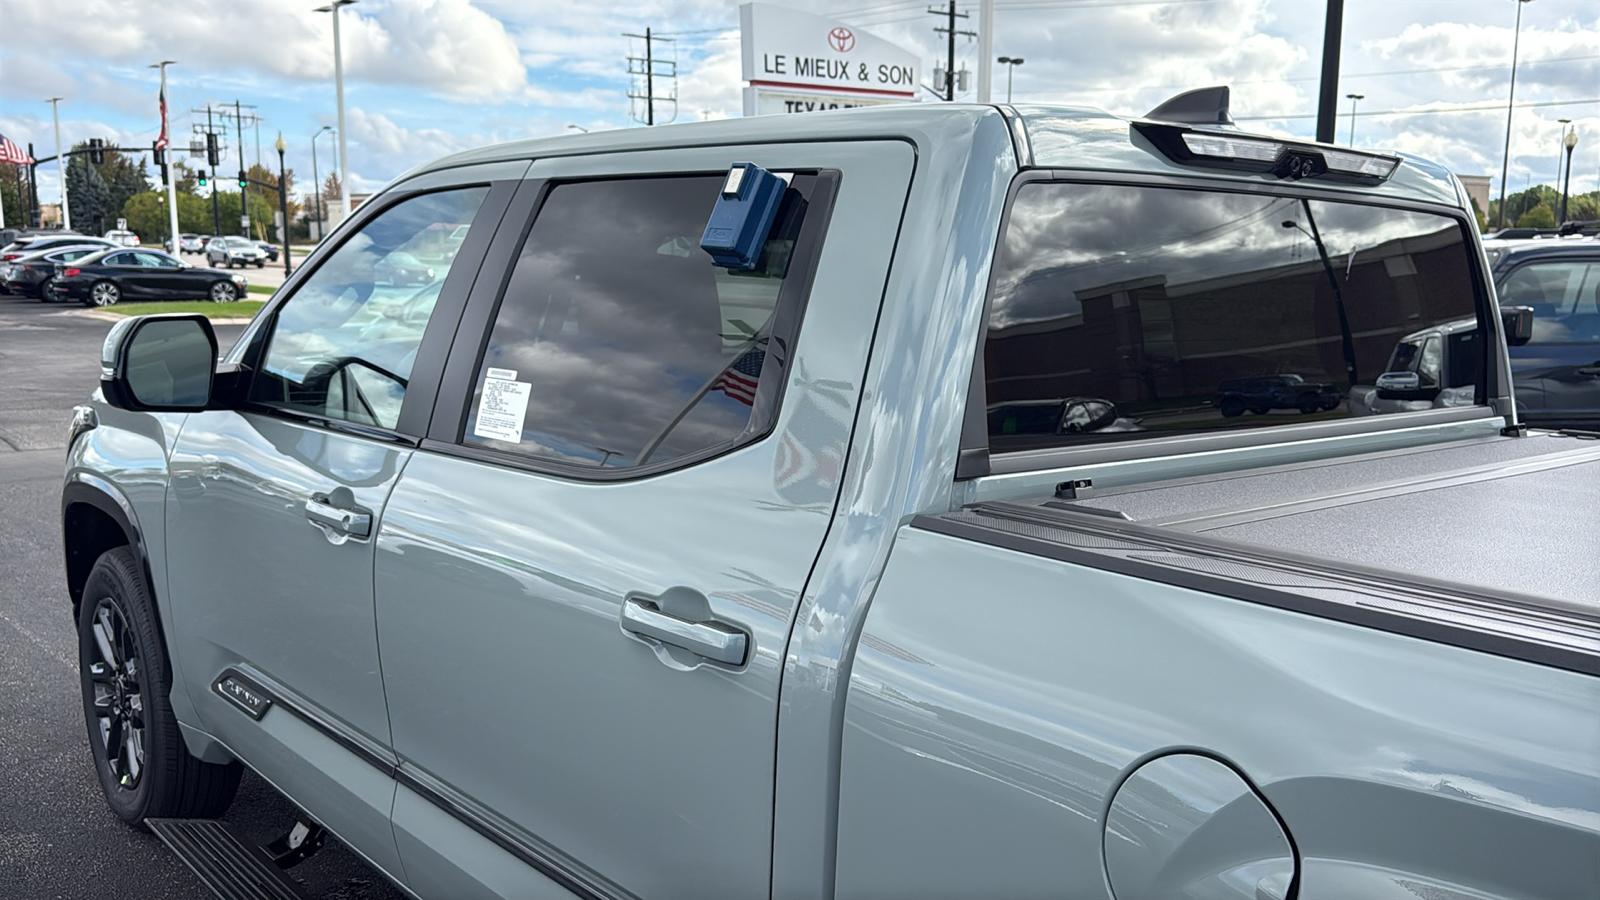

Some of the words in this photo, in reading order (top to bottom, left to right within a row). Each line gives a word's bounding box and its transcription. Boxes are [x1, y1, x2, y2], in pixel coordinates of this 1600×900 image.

[764, 53, 786, 75] LE
[795, 57, 850, 80] MIEUX
[858, 62, 869, 82] &
[878, 64, 913, 86] SON
